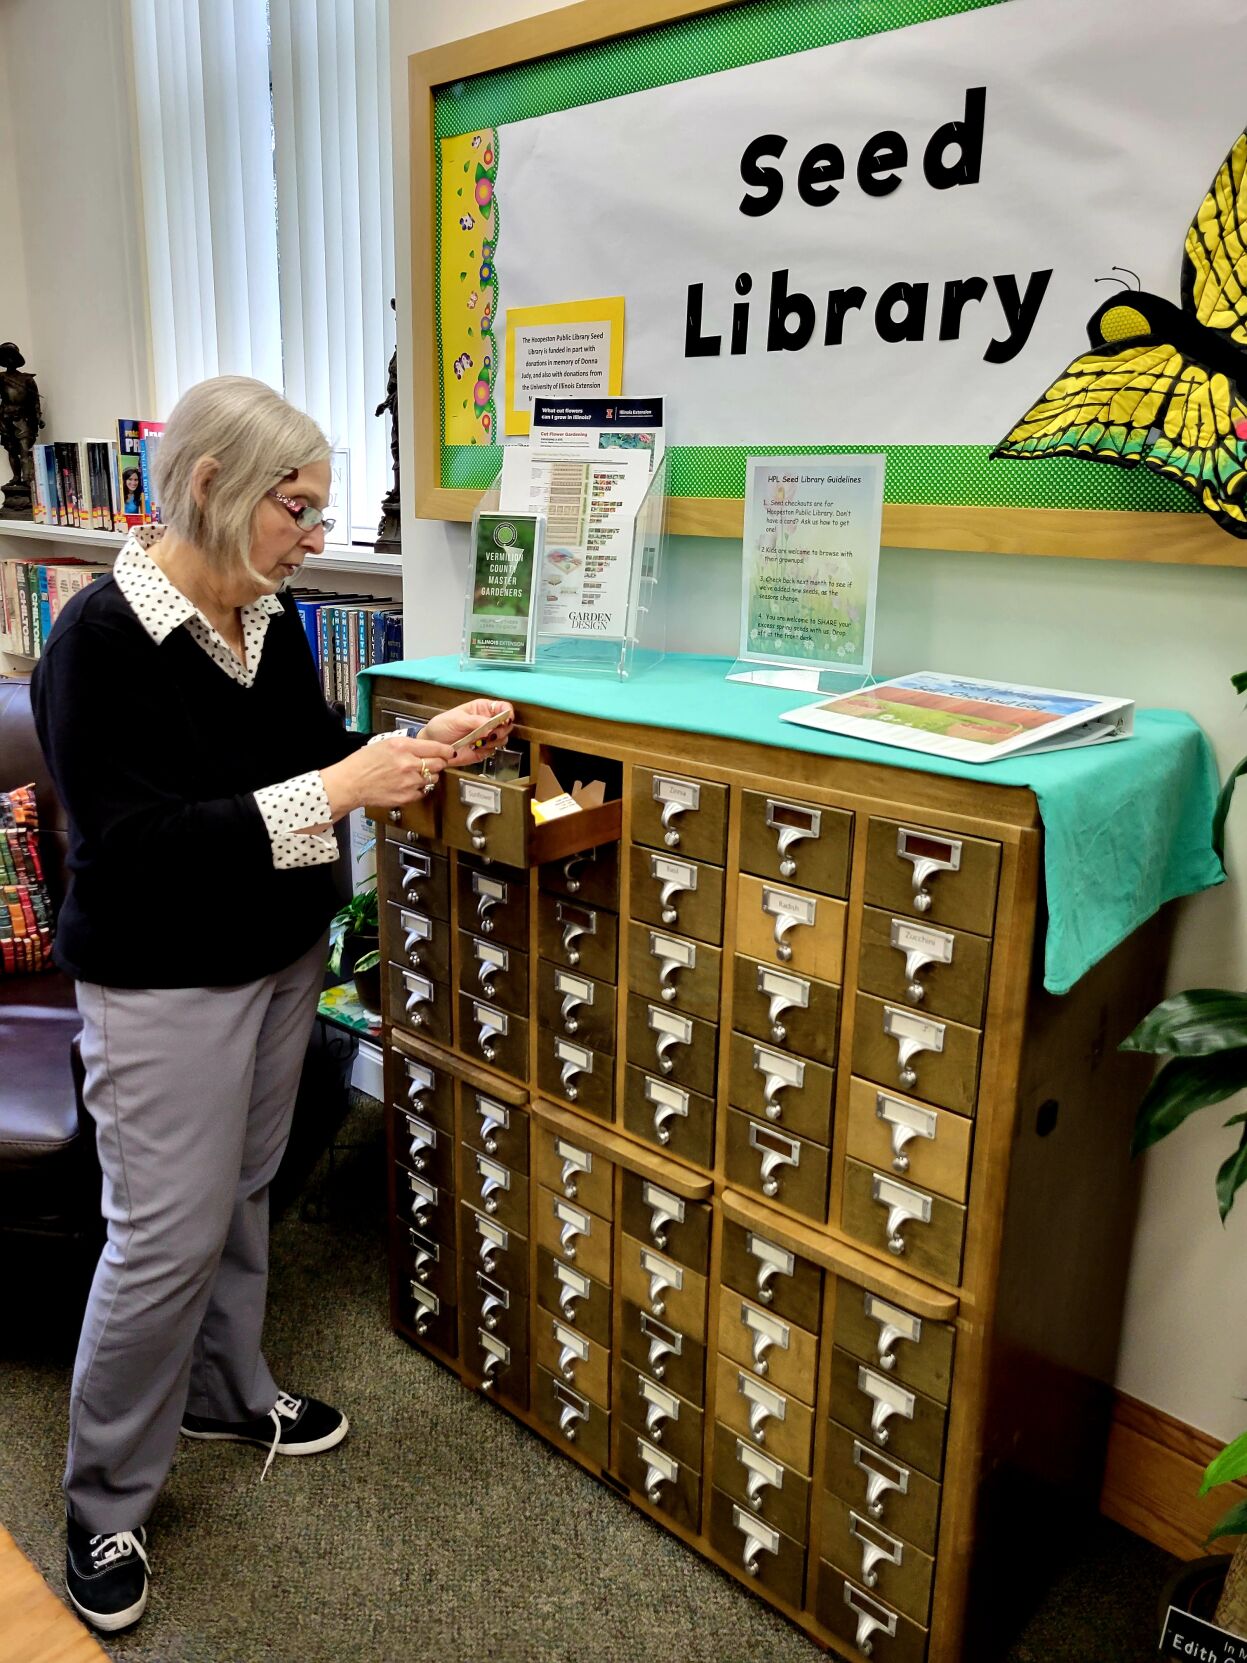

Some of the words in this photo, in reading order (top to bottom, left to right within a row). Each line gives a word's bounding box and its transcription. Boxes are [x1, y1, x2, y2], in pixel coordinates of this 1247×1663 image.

[738, 86, 986, 217] Seed
[685, 268, 1054, 364] Library
[800, 476, 824, 485] Library
[486, 552, 524, 562] VERMILION
[490, 564, 516, 573] COUNTY
[488, 576, 517, 585] MASTER
[481, 587, 523, 597] GARDENERS
[568, 611, 612, 622] GARDEN
[572, 620, 608, 630] DESIGN
[905, 931, 936, 946] Zucchini
[1172, 1633, 1217, 1663] Edith
[1224, 1641, 1235, 1654] In
